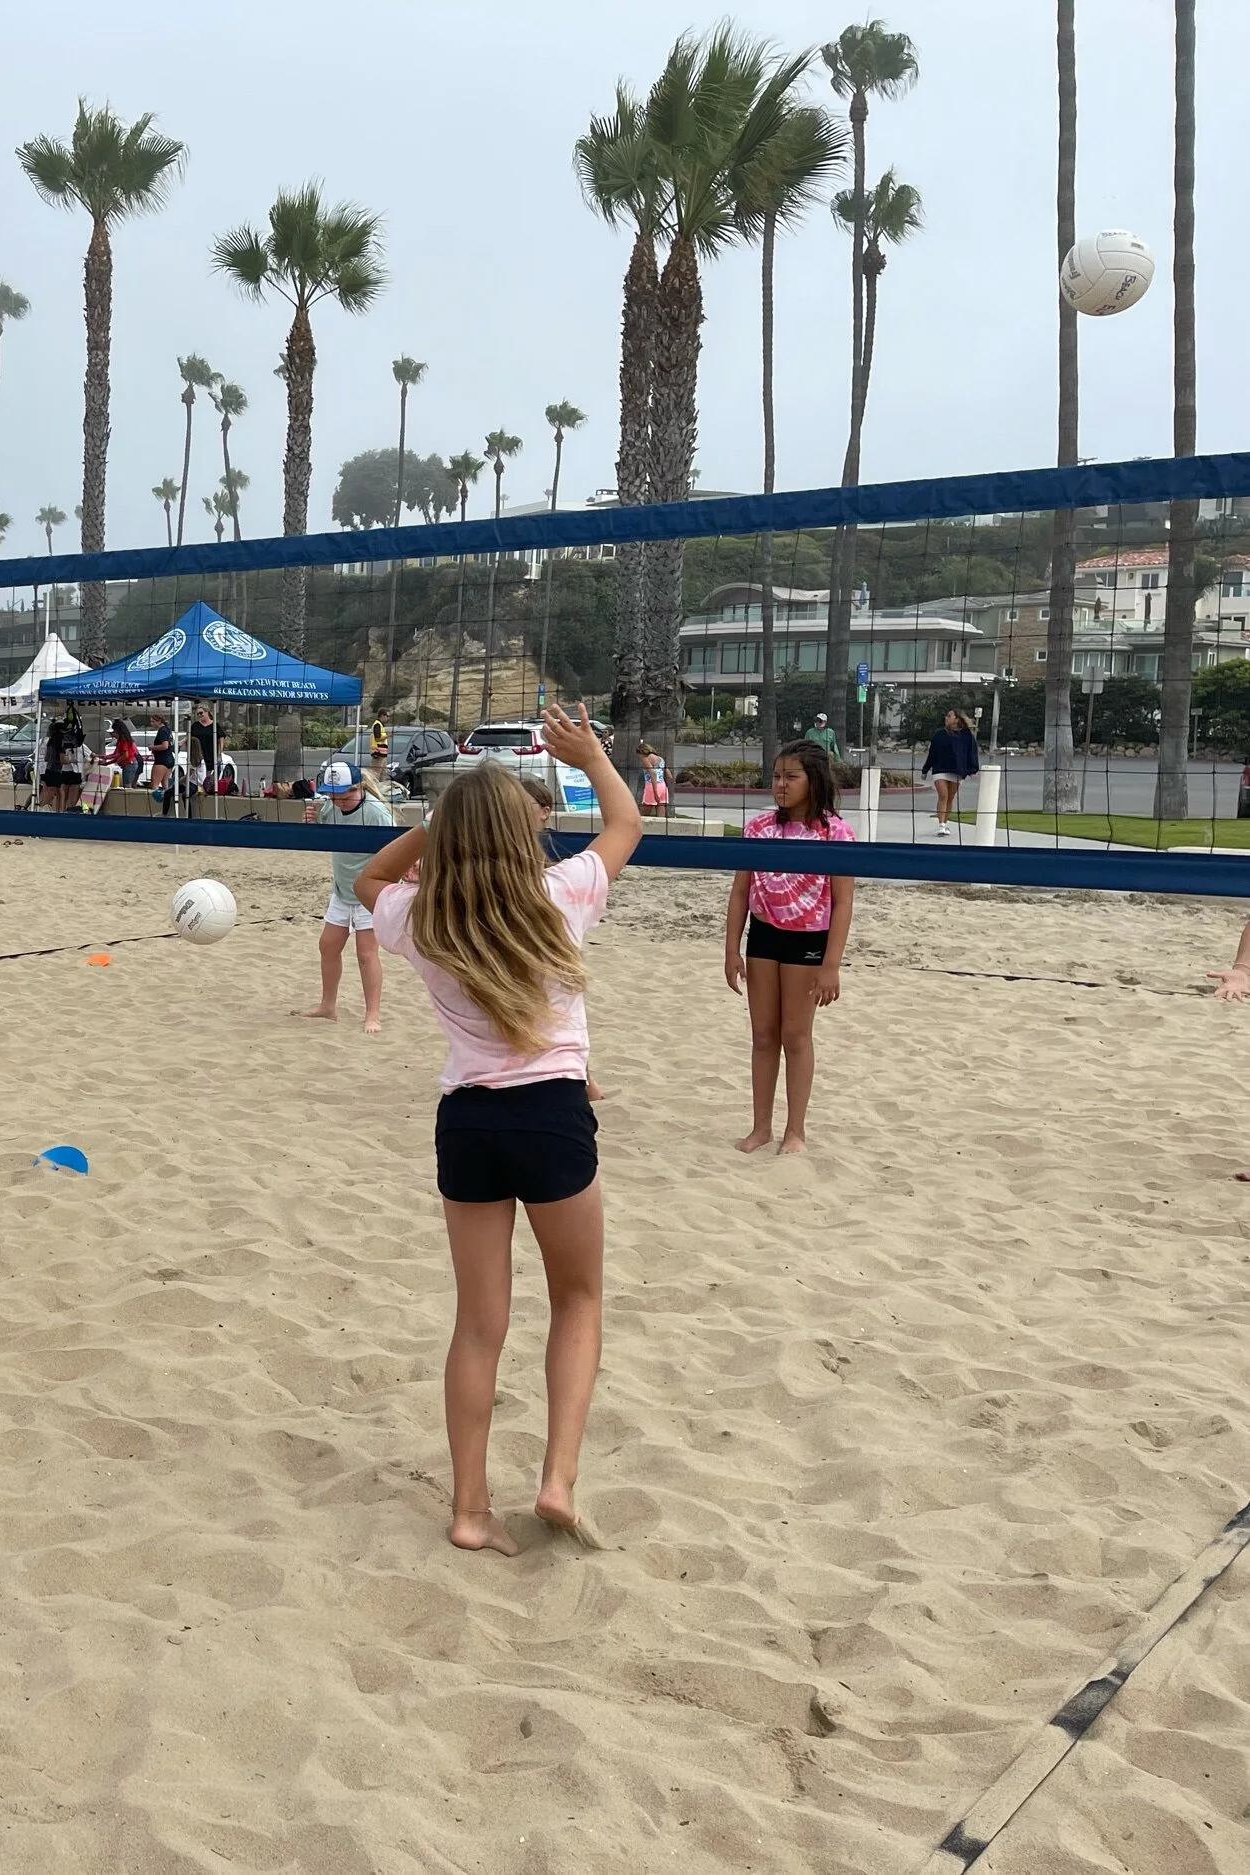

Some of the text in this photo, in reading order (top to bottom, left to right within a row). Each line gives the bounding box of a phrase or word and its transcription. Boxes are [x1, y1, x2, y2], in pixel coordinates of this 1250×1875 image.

[254, 678, 291, 688] NEWPORT
[292, 681, 317, 690] BEACH
[213, 687, 329, 700] RECREATION & SENIOR SERVICES
